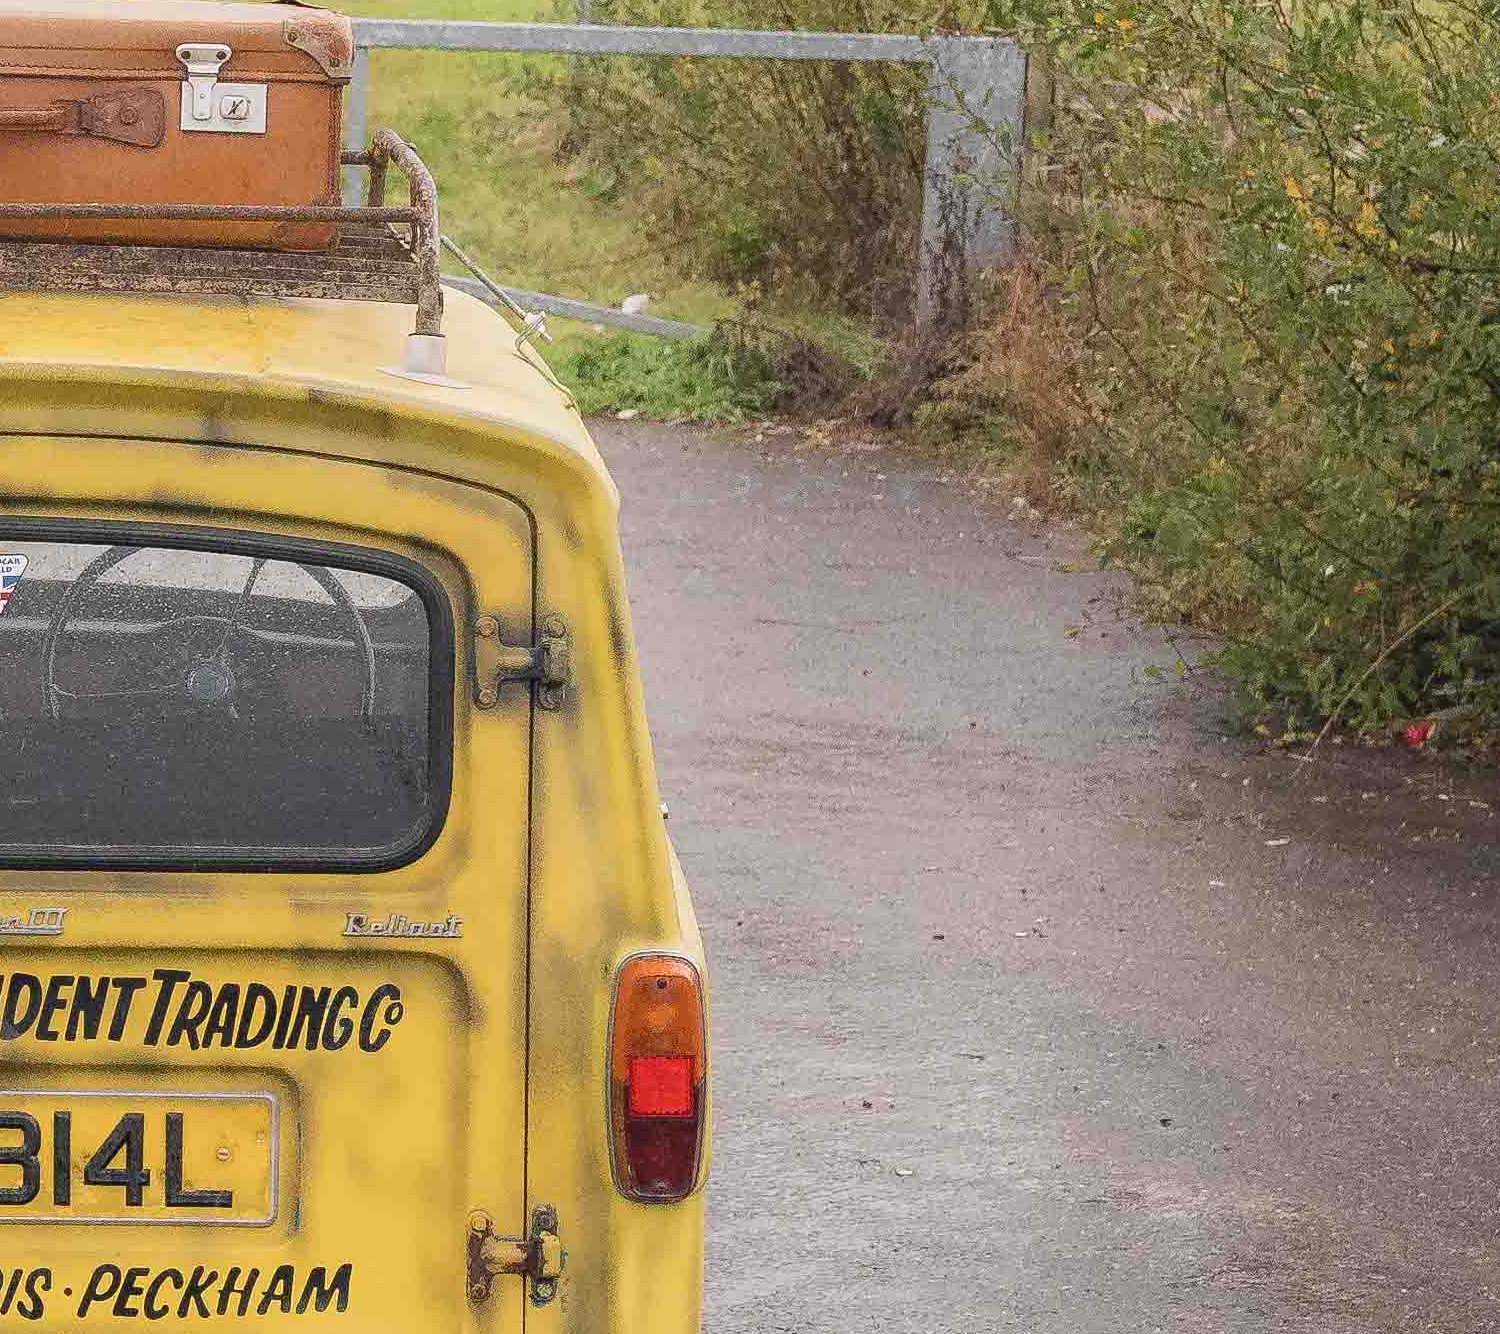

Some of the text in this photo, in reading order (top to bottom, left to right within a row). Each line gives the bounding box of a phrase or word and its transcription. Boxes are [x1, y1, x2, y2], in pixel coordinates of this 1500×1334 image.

[342, 913, 464, 938] Reliant
[143, 968, 359, 1051] TRADING
[76, 1263, 353, 1321] PECKHAM
